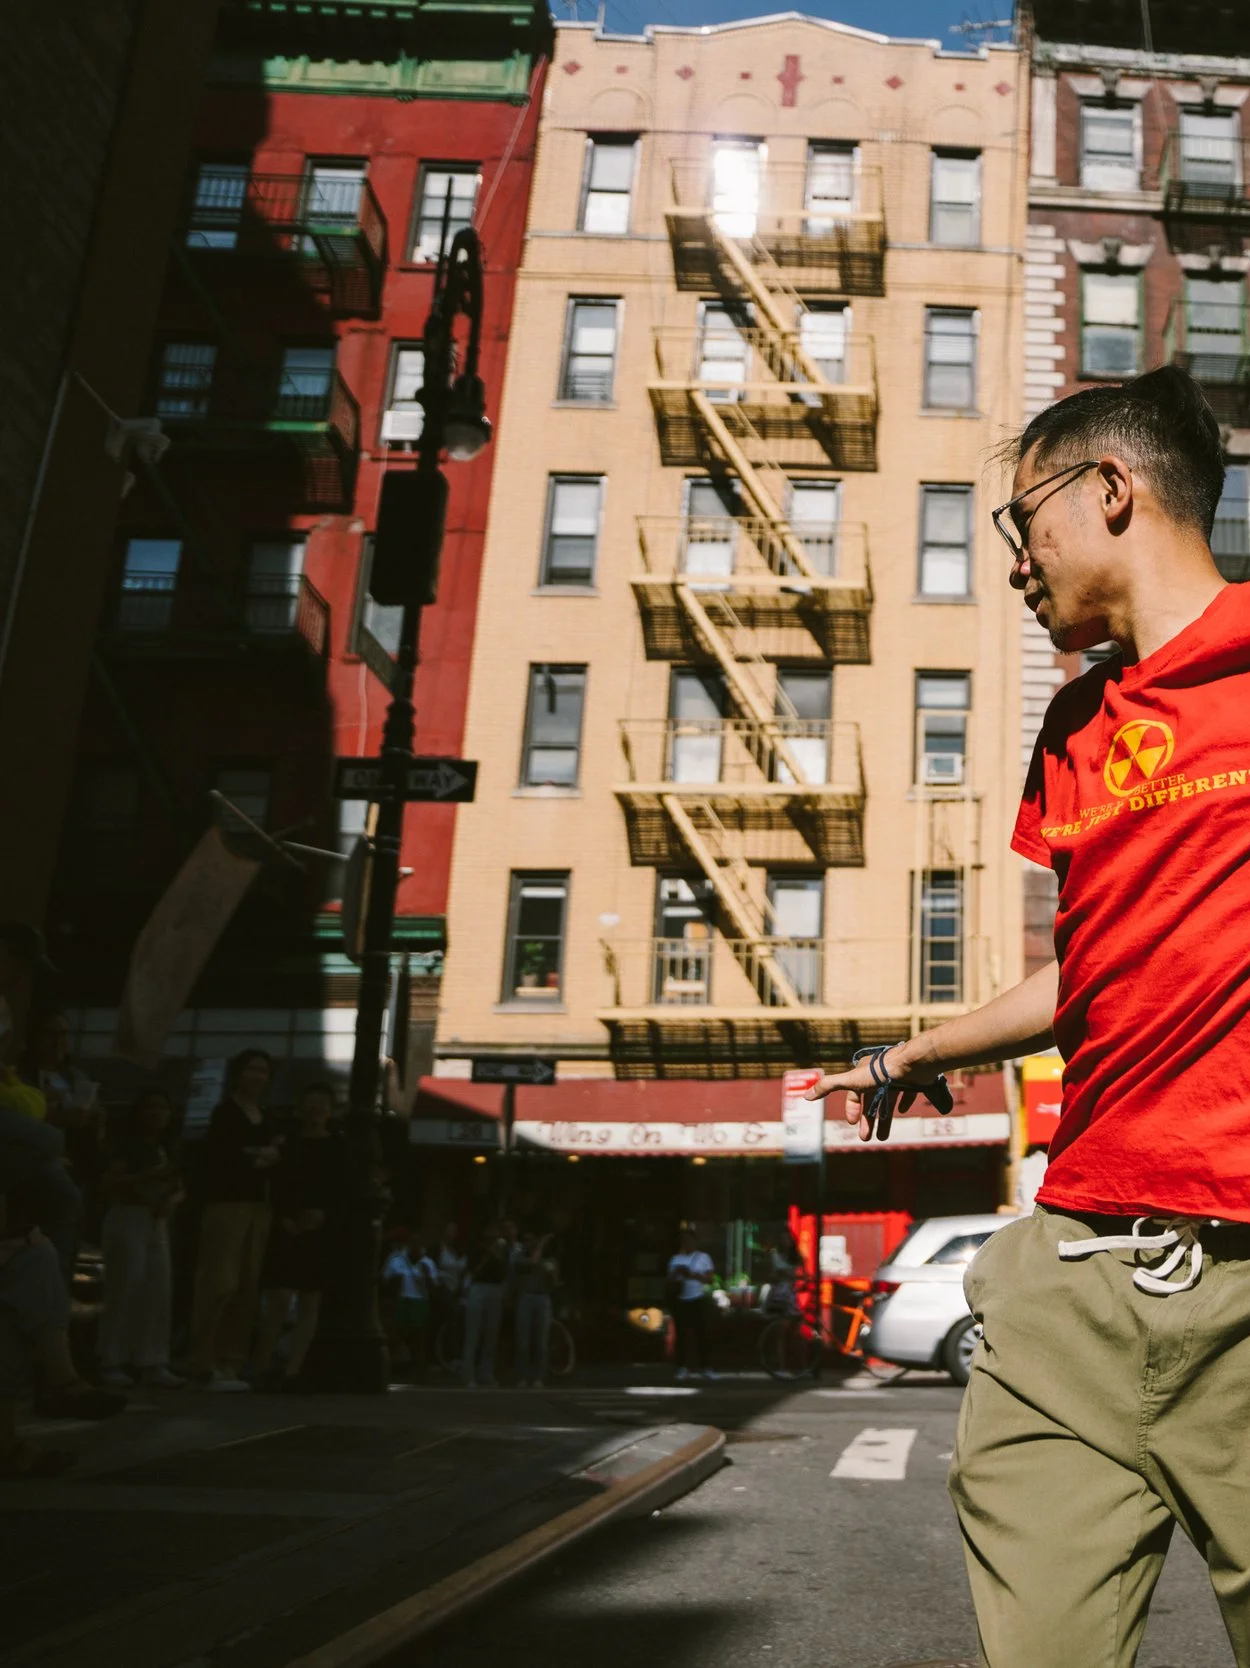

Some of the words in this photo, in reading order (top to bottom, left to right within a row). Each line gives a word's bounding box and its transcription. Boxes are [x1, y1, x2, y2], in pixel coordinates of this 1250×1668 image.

[414, 769, 457, 789] WAY
[1132, 773, 1187, 796] BETTER
[627, 1123, 662, 1146] On
